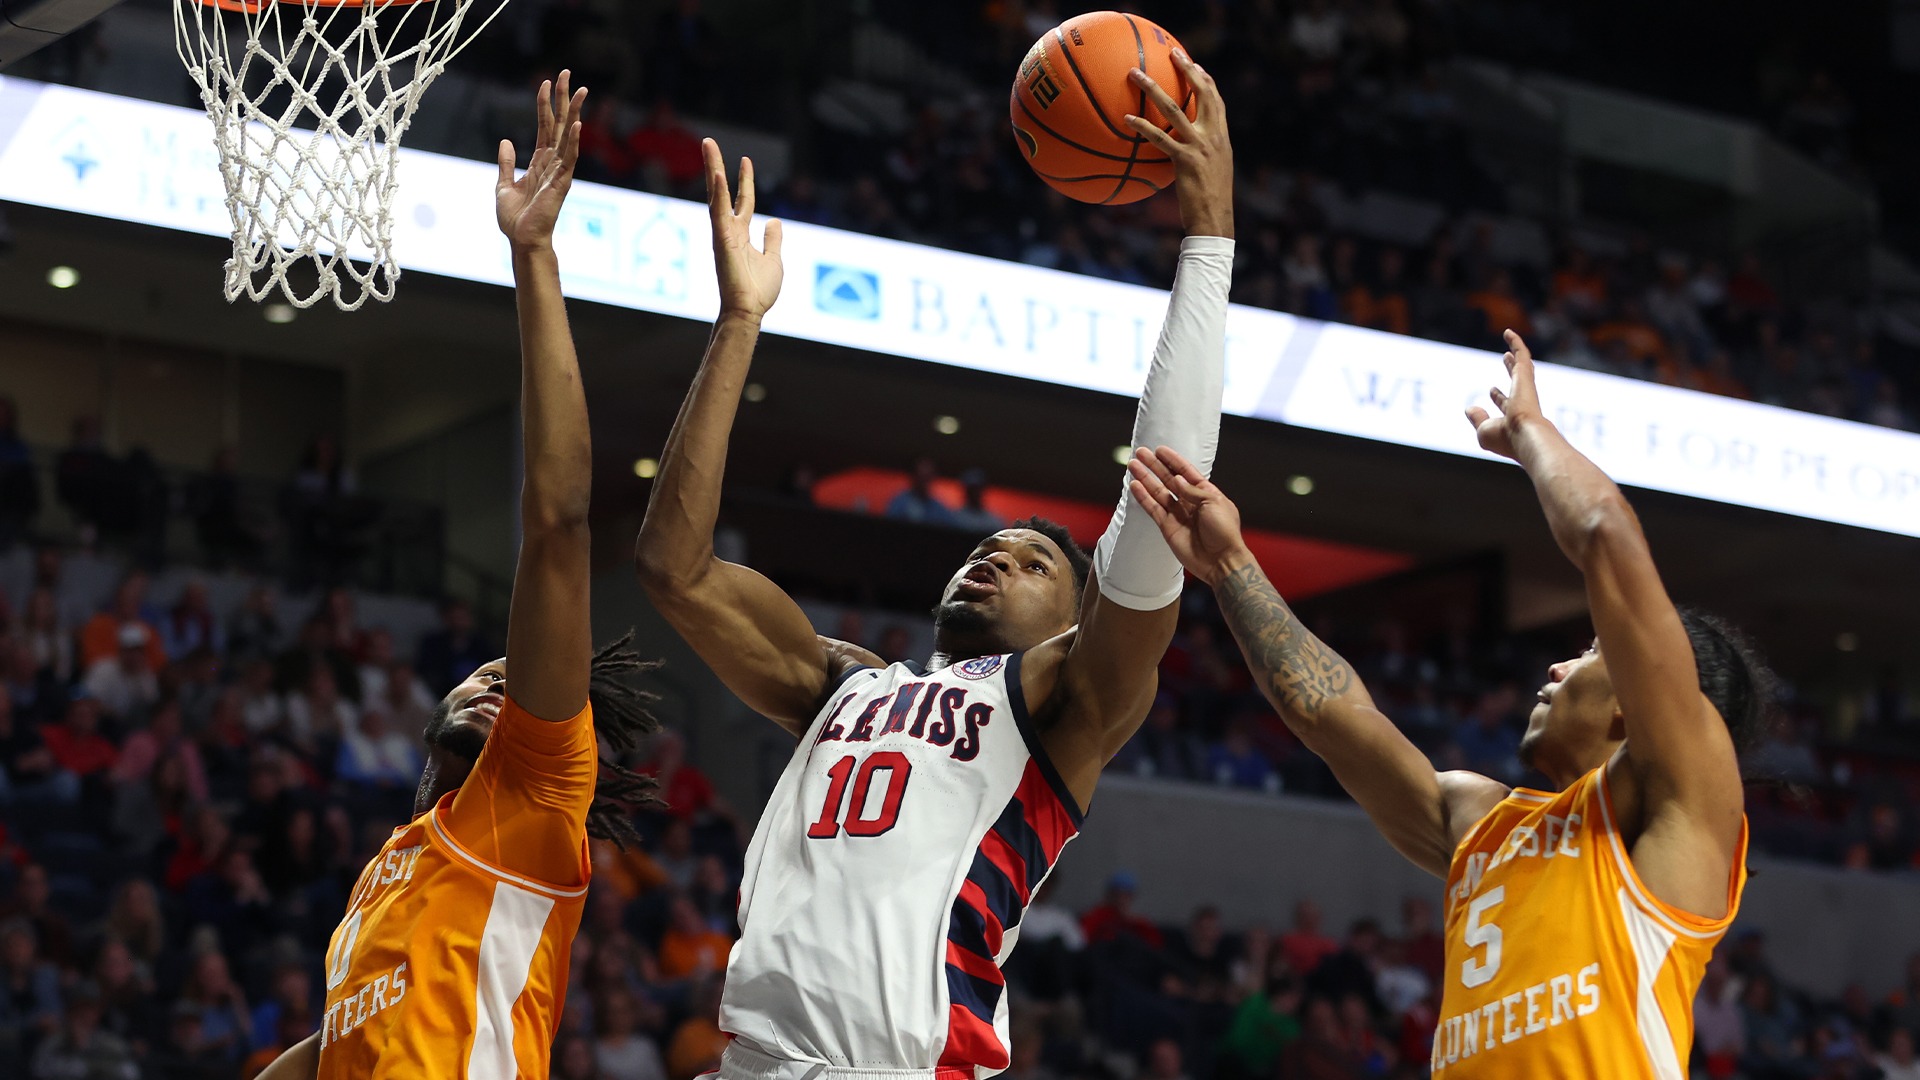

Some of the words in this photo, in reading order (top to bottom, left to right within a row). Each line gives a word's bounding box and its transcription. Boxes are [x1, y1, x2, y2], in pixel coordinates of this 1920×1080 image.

[910, 276, 1243, 389] BAPTI
[1646, 423, 1757, 475] FOR
[811, 692, 895, 748] LE
[807, 751, 912, 839] 10
[1461, 885, 1504, 989] 5
